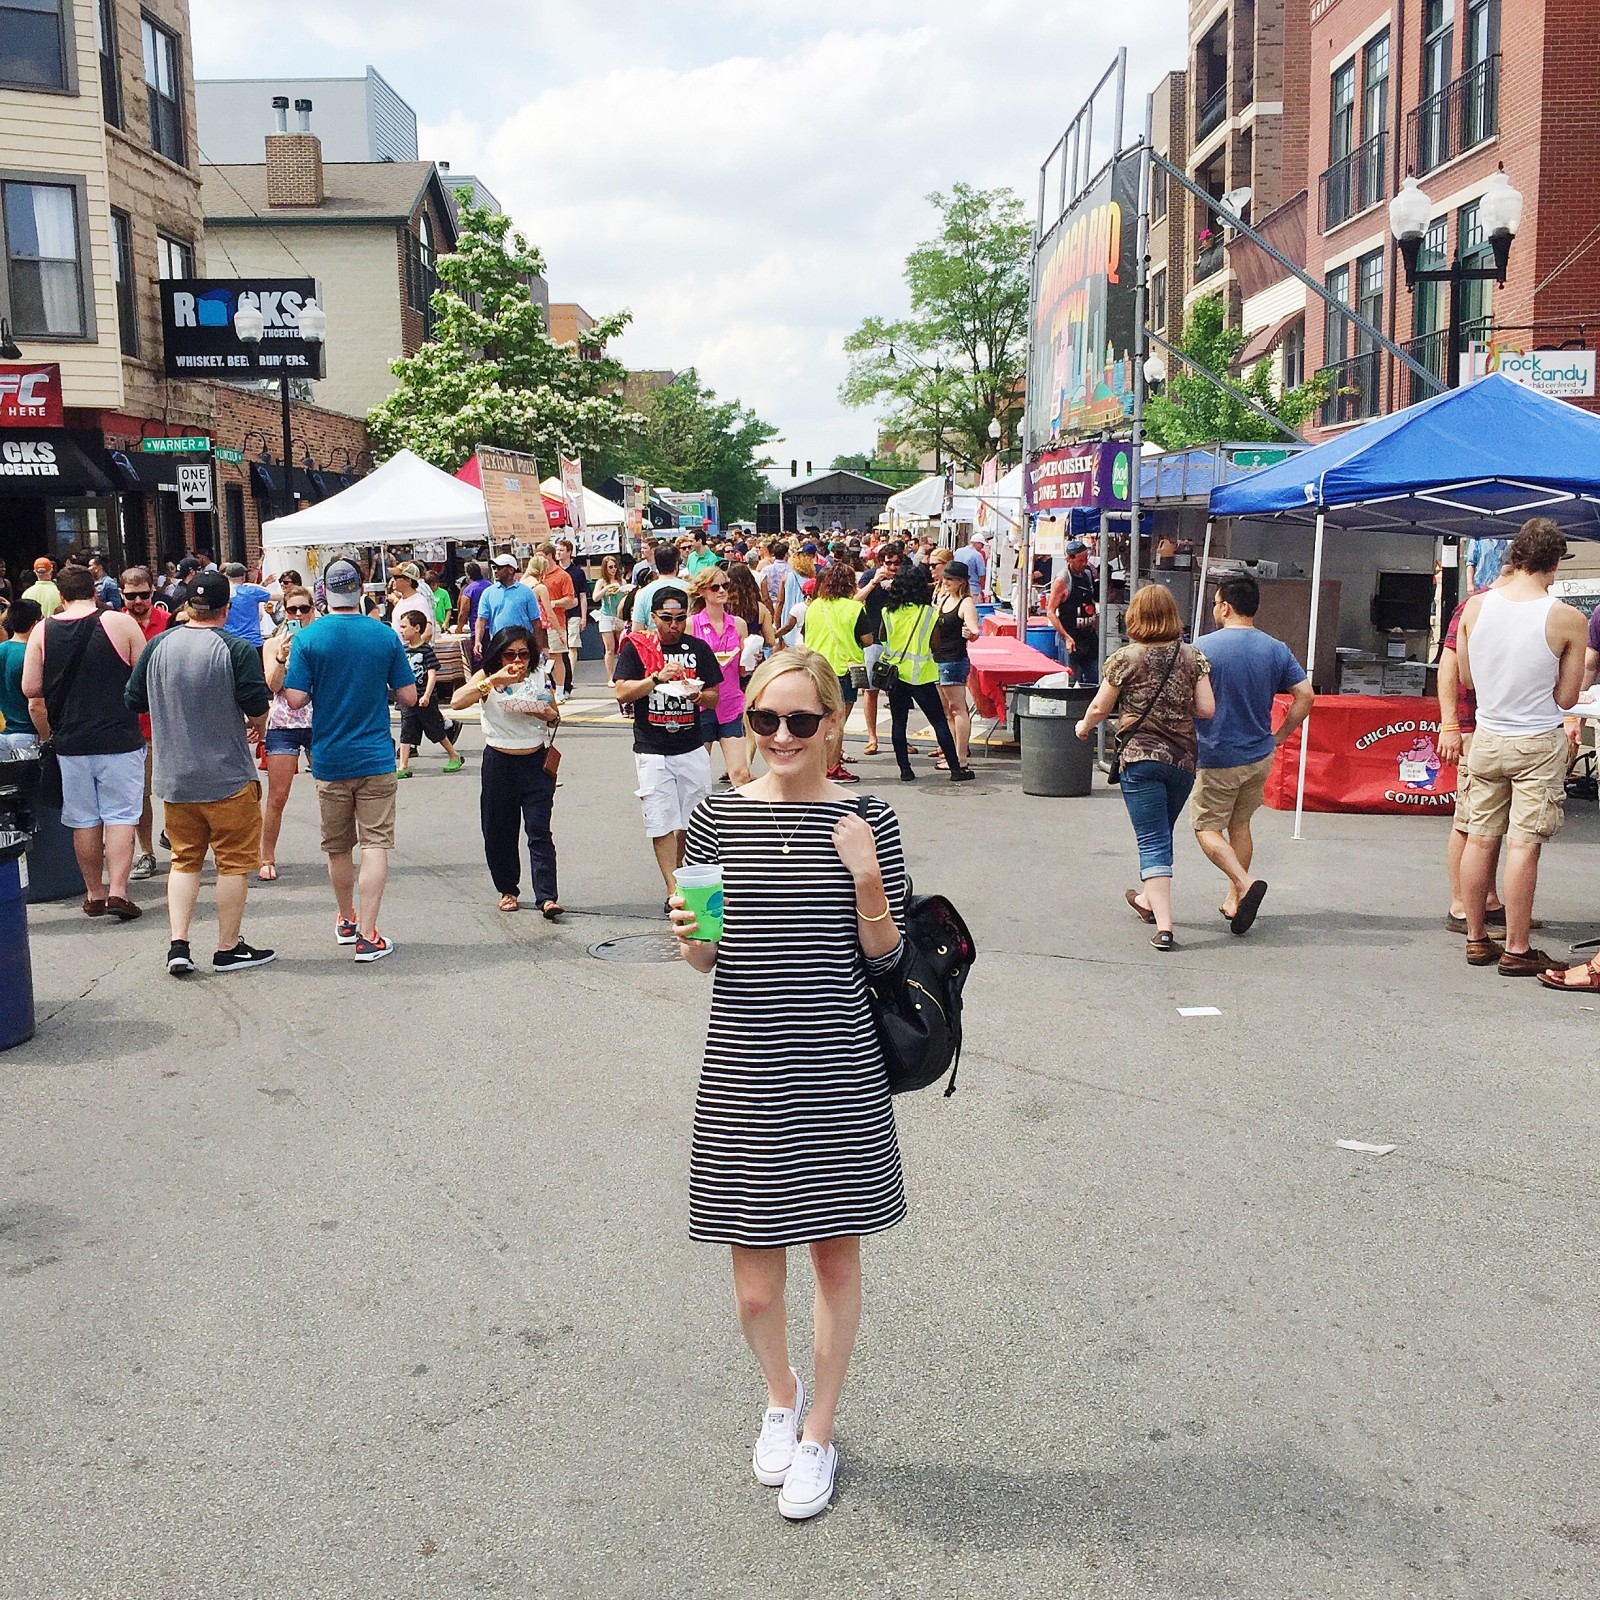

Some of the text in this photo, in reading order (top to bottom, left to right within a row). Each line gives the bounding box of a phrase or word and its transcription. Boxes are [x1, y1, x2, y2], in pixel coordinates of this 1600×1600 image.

[1087, 201, 1122, 284] BBQ
[176, 355, 225, 367] WHISKEY.
[259, 354, 309, 367] BURERS.
[1502, 354, 1541, 371] rock
[1531, 364, 1587, 386] candy
[1545, 381, 1577, 389] centered
[1569, 388, 1584, 396] spa
[8, 406, 46, 417] HERE
[152, 439, 196, 450] WARNER
[181, 468, 207, 480] ONE
[181, 481, 207, 493] WAY
[1355, 720, 1442, 751] CHICAGO BA
[1384, 789, 1458, 806] COMPANY
